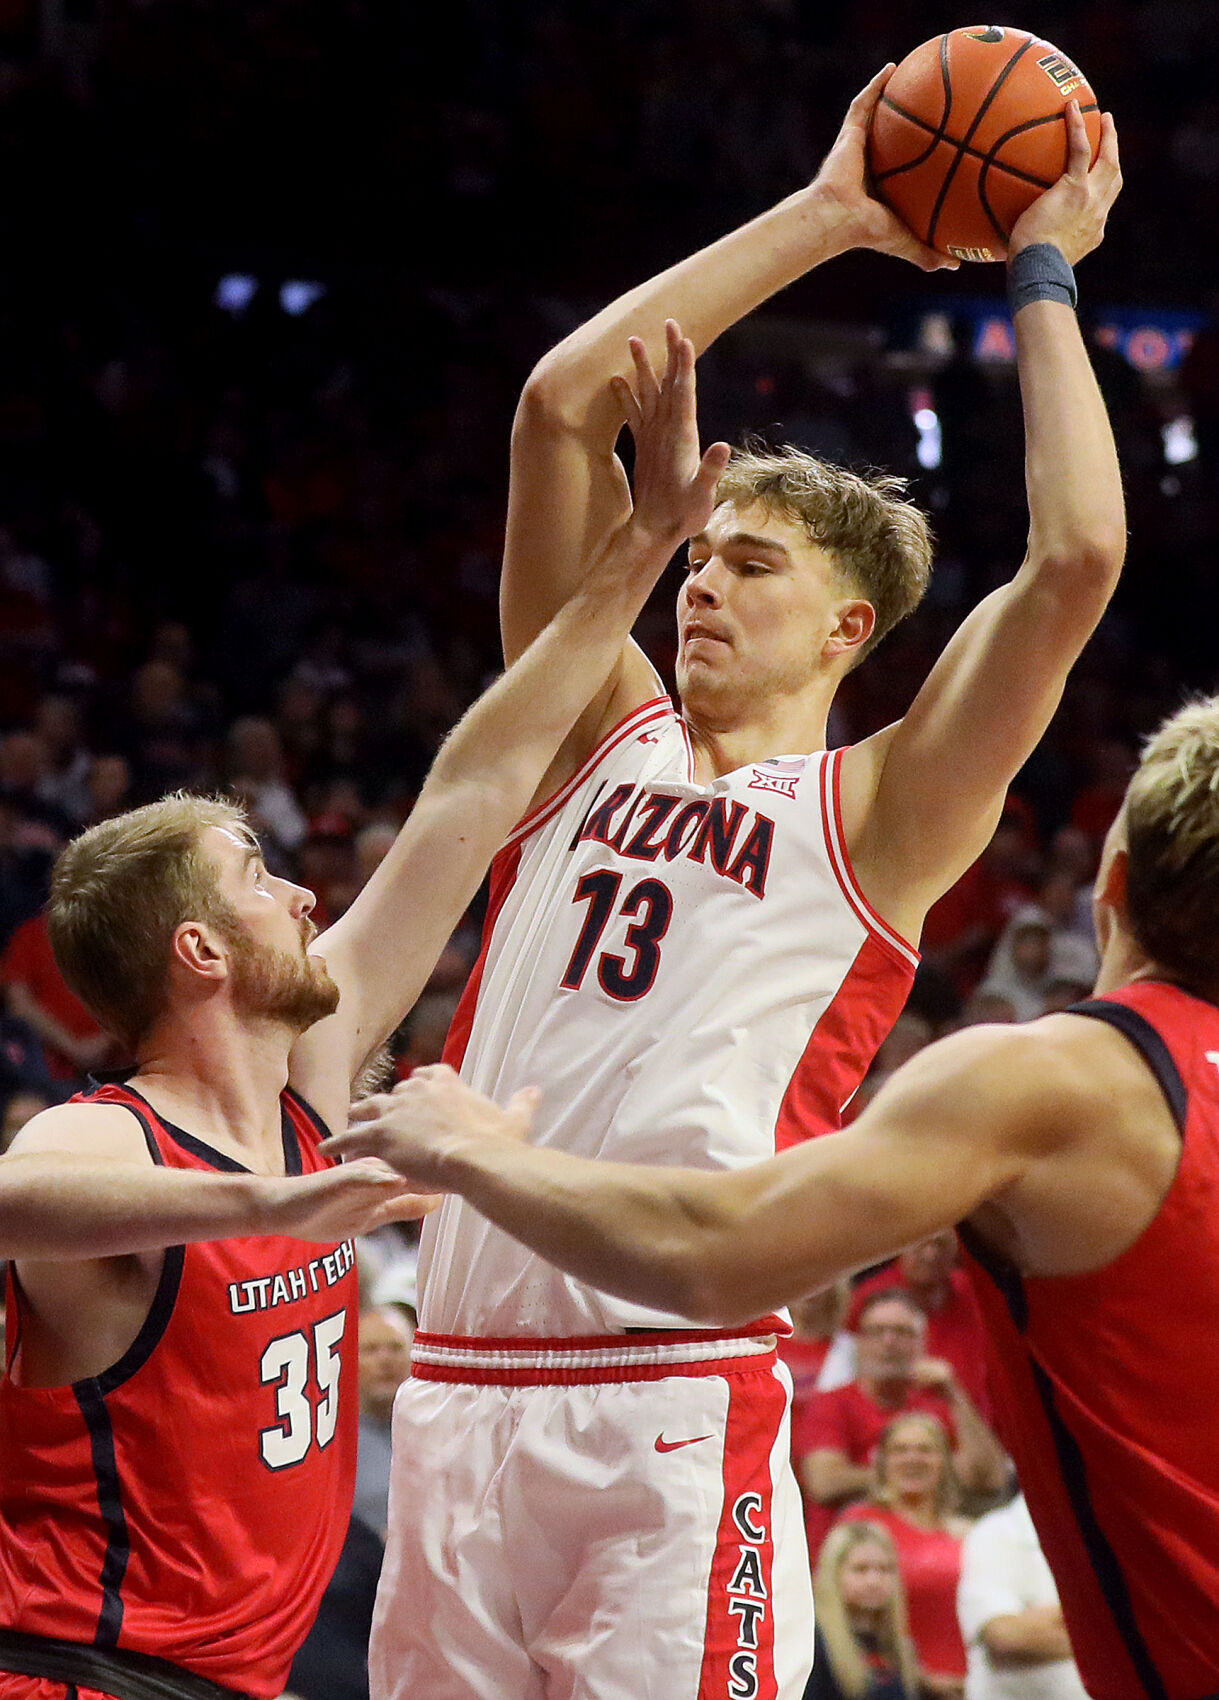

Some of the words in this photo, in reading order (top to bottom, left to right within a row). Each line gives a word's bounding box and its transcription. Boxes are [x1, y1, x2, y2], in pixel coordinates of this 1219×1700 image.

[559, 868, 674, 1002] 13
[229, 1268, 307, 1315] UTAH
[259, 1306, 346, 1472] 35
[727, 1491, 768, 1700] CATS
